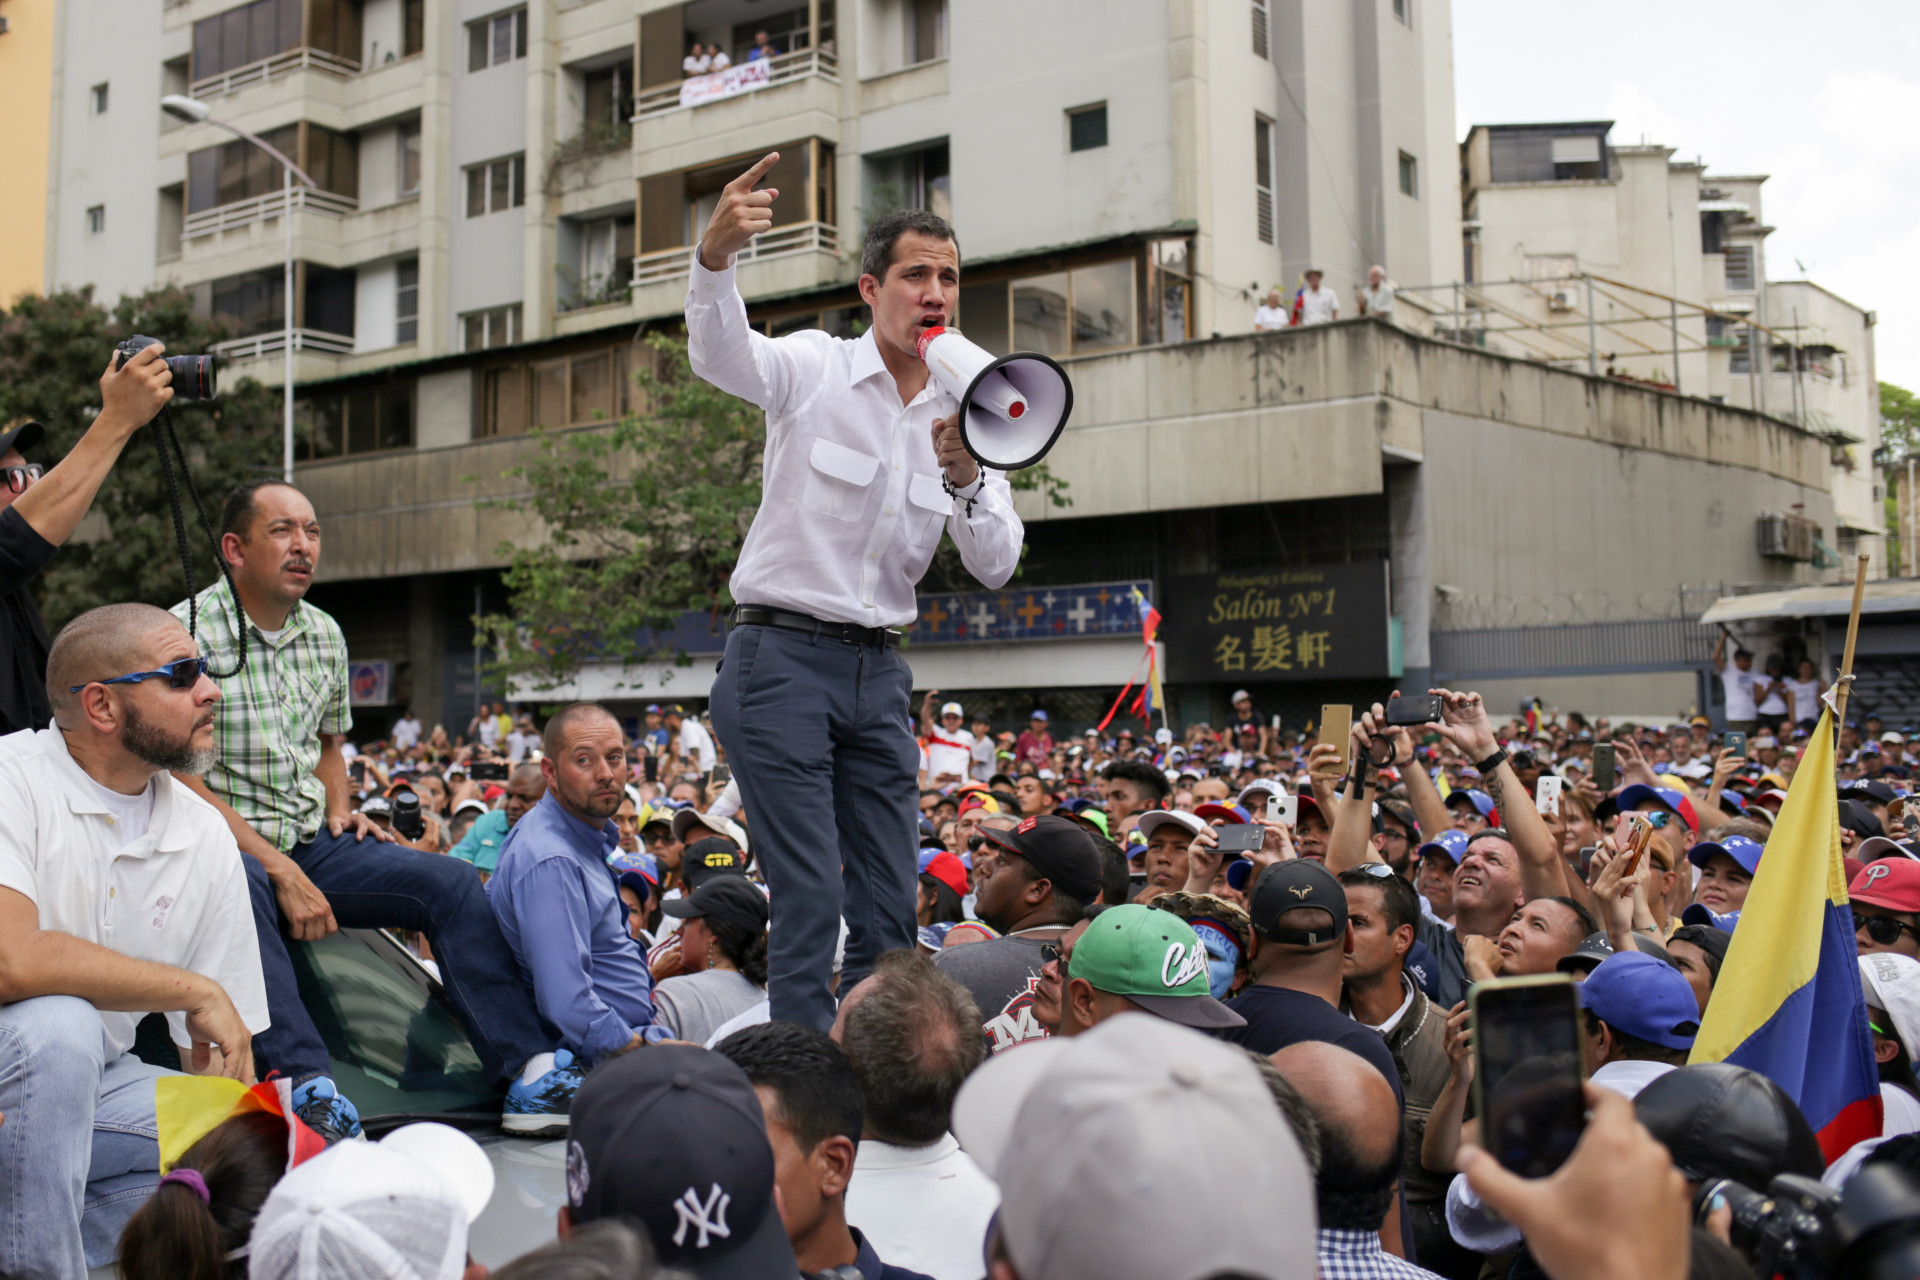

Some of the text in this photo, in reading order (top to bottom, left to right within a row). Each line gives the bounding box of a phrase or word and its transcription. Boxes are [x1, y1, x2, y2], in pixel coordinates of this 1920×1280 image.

[1208, 588, 1282, 624] Salón
[1861, 864, 1890, 890] P
[672, 1182, 731, 1248] NY
